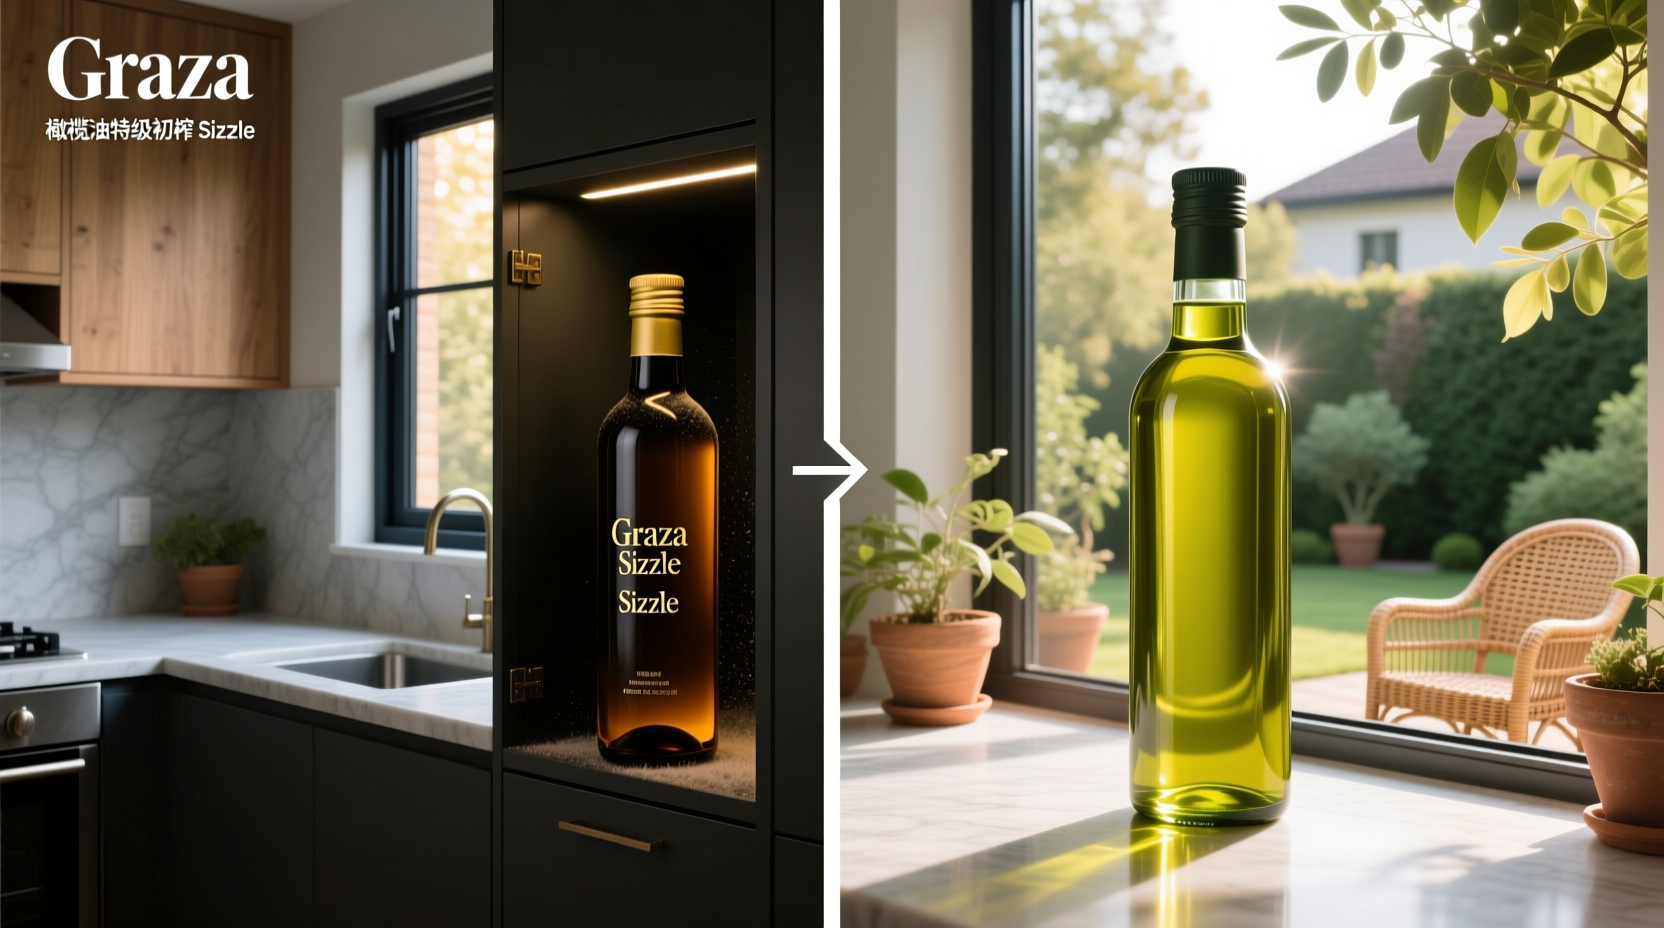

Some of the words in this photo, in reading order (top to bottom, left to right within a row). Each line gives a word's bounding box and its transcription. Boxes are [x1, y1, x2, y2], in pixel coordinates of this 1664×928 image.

[611, 517, 689, 547] Graza
[618, 550, 682, 576] Sizzle
[618, 589, 680, 614] Sizzle
